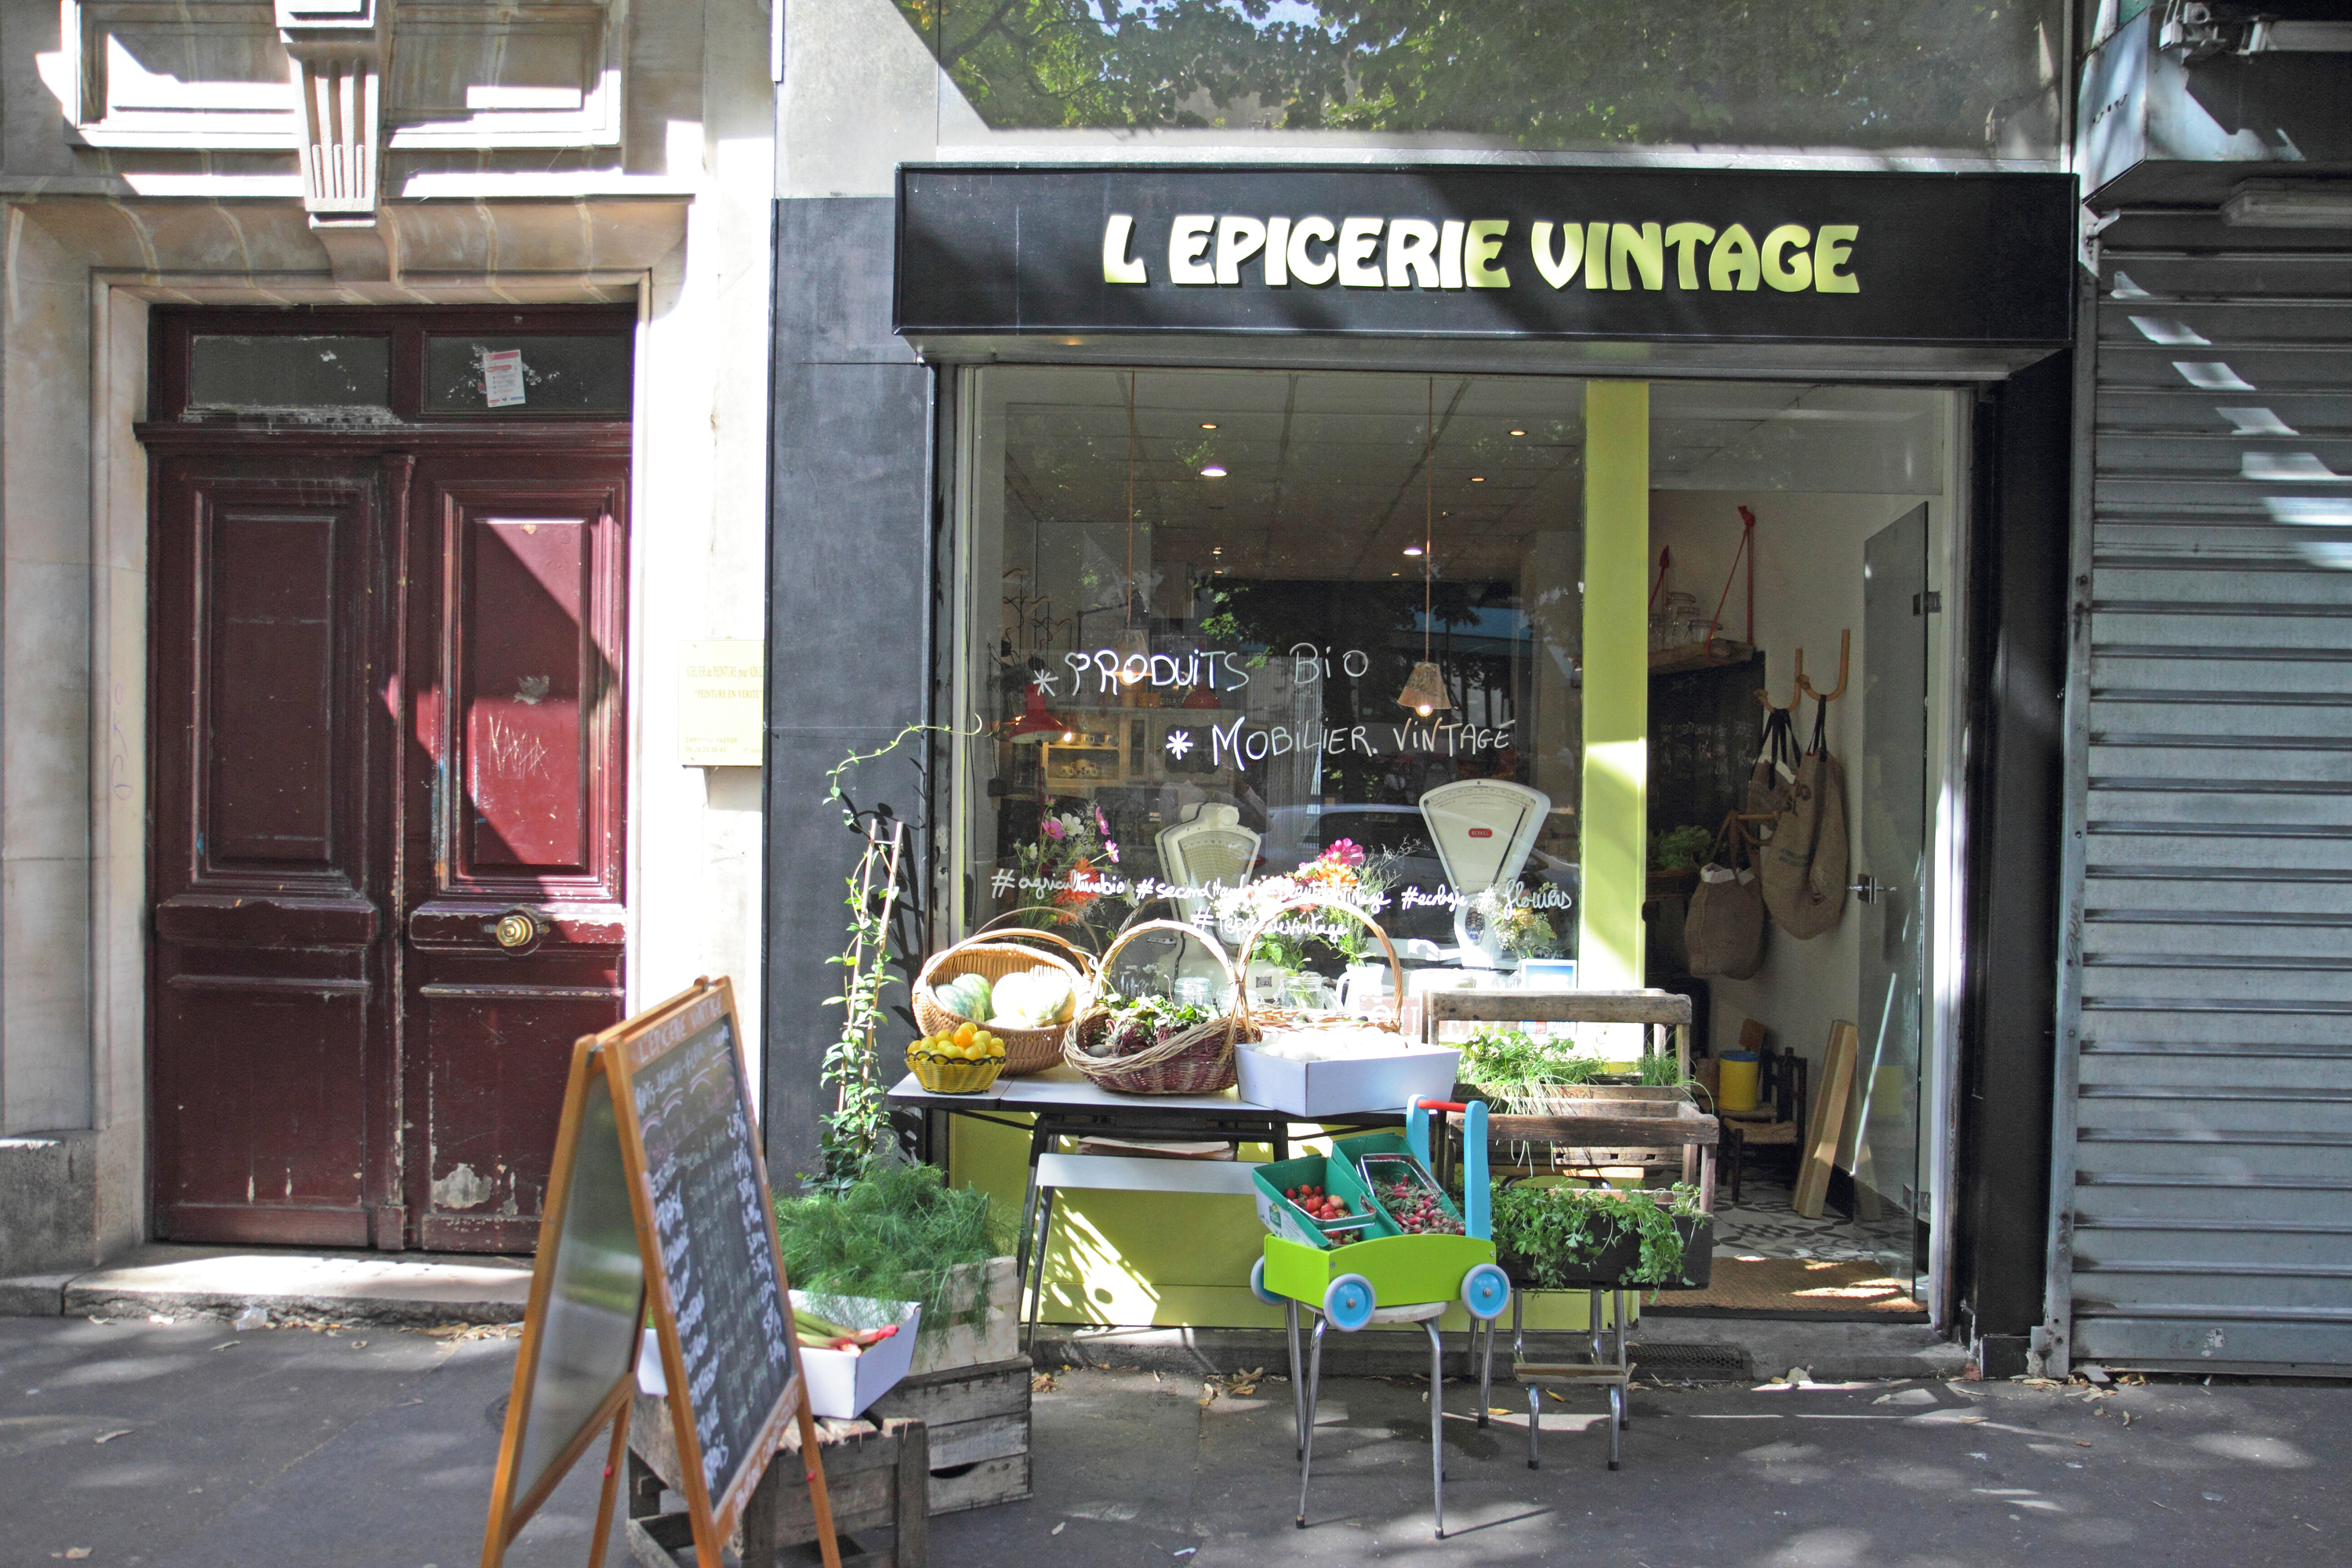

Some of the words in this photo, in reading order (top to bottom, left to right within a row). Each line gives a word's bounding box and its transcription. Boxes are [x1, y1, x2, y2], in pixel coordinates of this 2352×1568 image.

[1102, 212, 1147, 284] L
[1169, 213, 1510, 289] EPICERIE
[1531, 222, 1860, 293] VINTAGE
[713, 666, 737, 677] PEINTURE
[728, 689, 736, 699] EN
